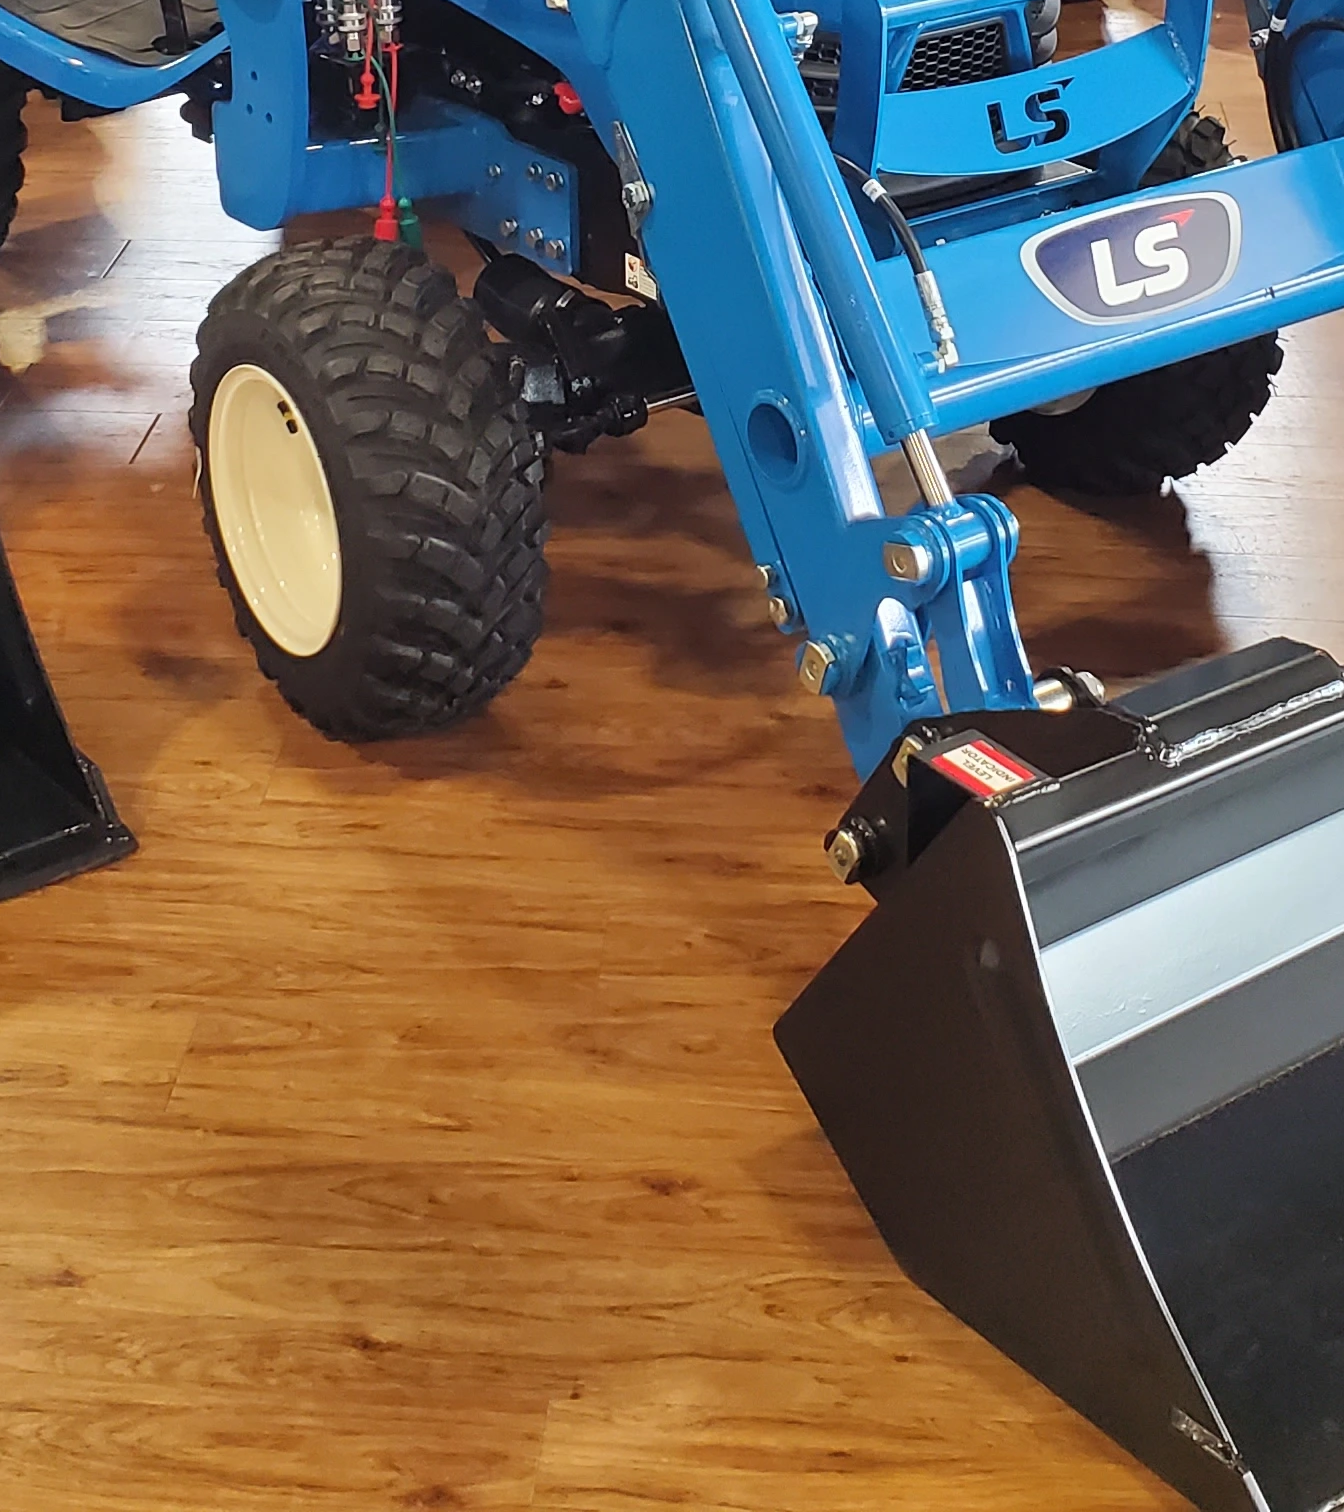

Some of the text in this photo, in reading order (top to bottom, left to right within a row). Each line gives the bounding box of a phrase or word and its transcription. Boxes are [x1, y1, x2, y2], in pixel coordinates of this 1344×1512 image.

[986, 86, 1071, 155] LS
[1090, 221, 1190, 307] LS
[961, 747, 1016, 783] INDICATOR
[962, 759, 993, 781] LEVEL
